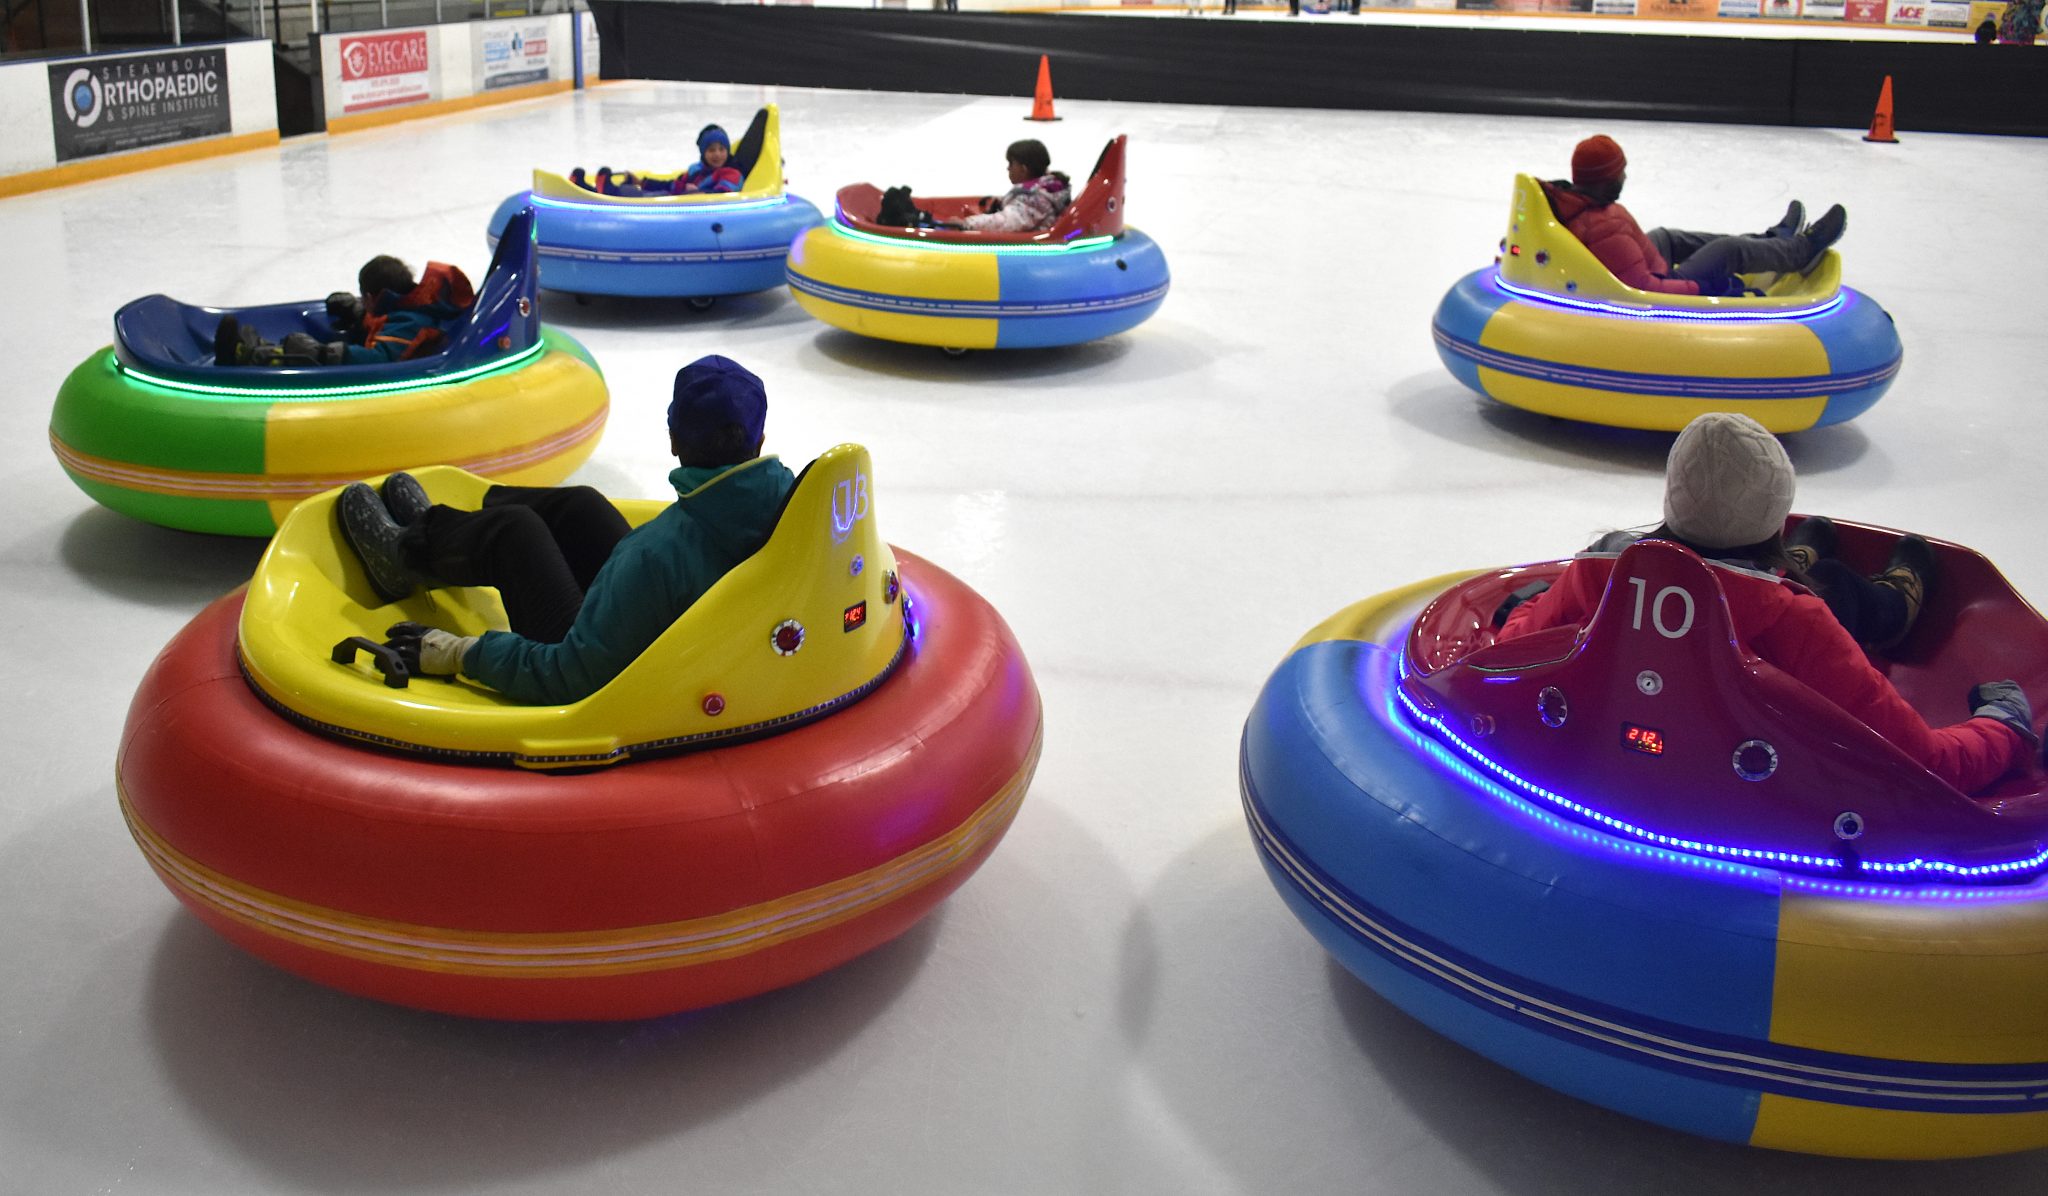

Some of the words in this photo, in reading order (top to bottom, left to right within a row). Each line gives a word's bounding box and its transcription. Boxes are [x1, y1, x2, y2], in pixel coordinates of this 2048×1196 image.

[1894, 6, 1924, 18] ACE
[368, 37, 426, 65] EYECARE
[102, 55, 217, 81] STEAMBOAT
[106, 109, 115, 122] &
[121, 102, 157, 120] SPINE
[162, 94, 219, 113] INSTITUTE
[1628, 576, 1695, 639] 10
